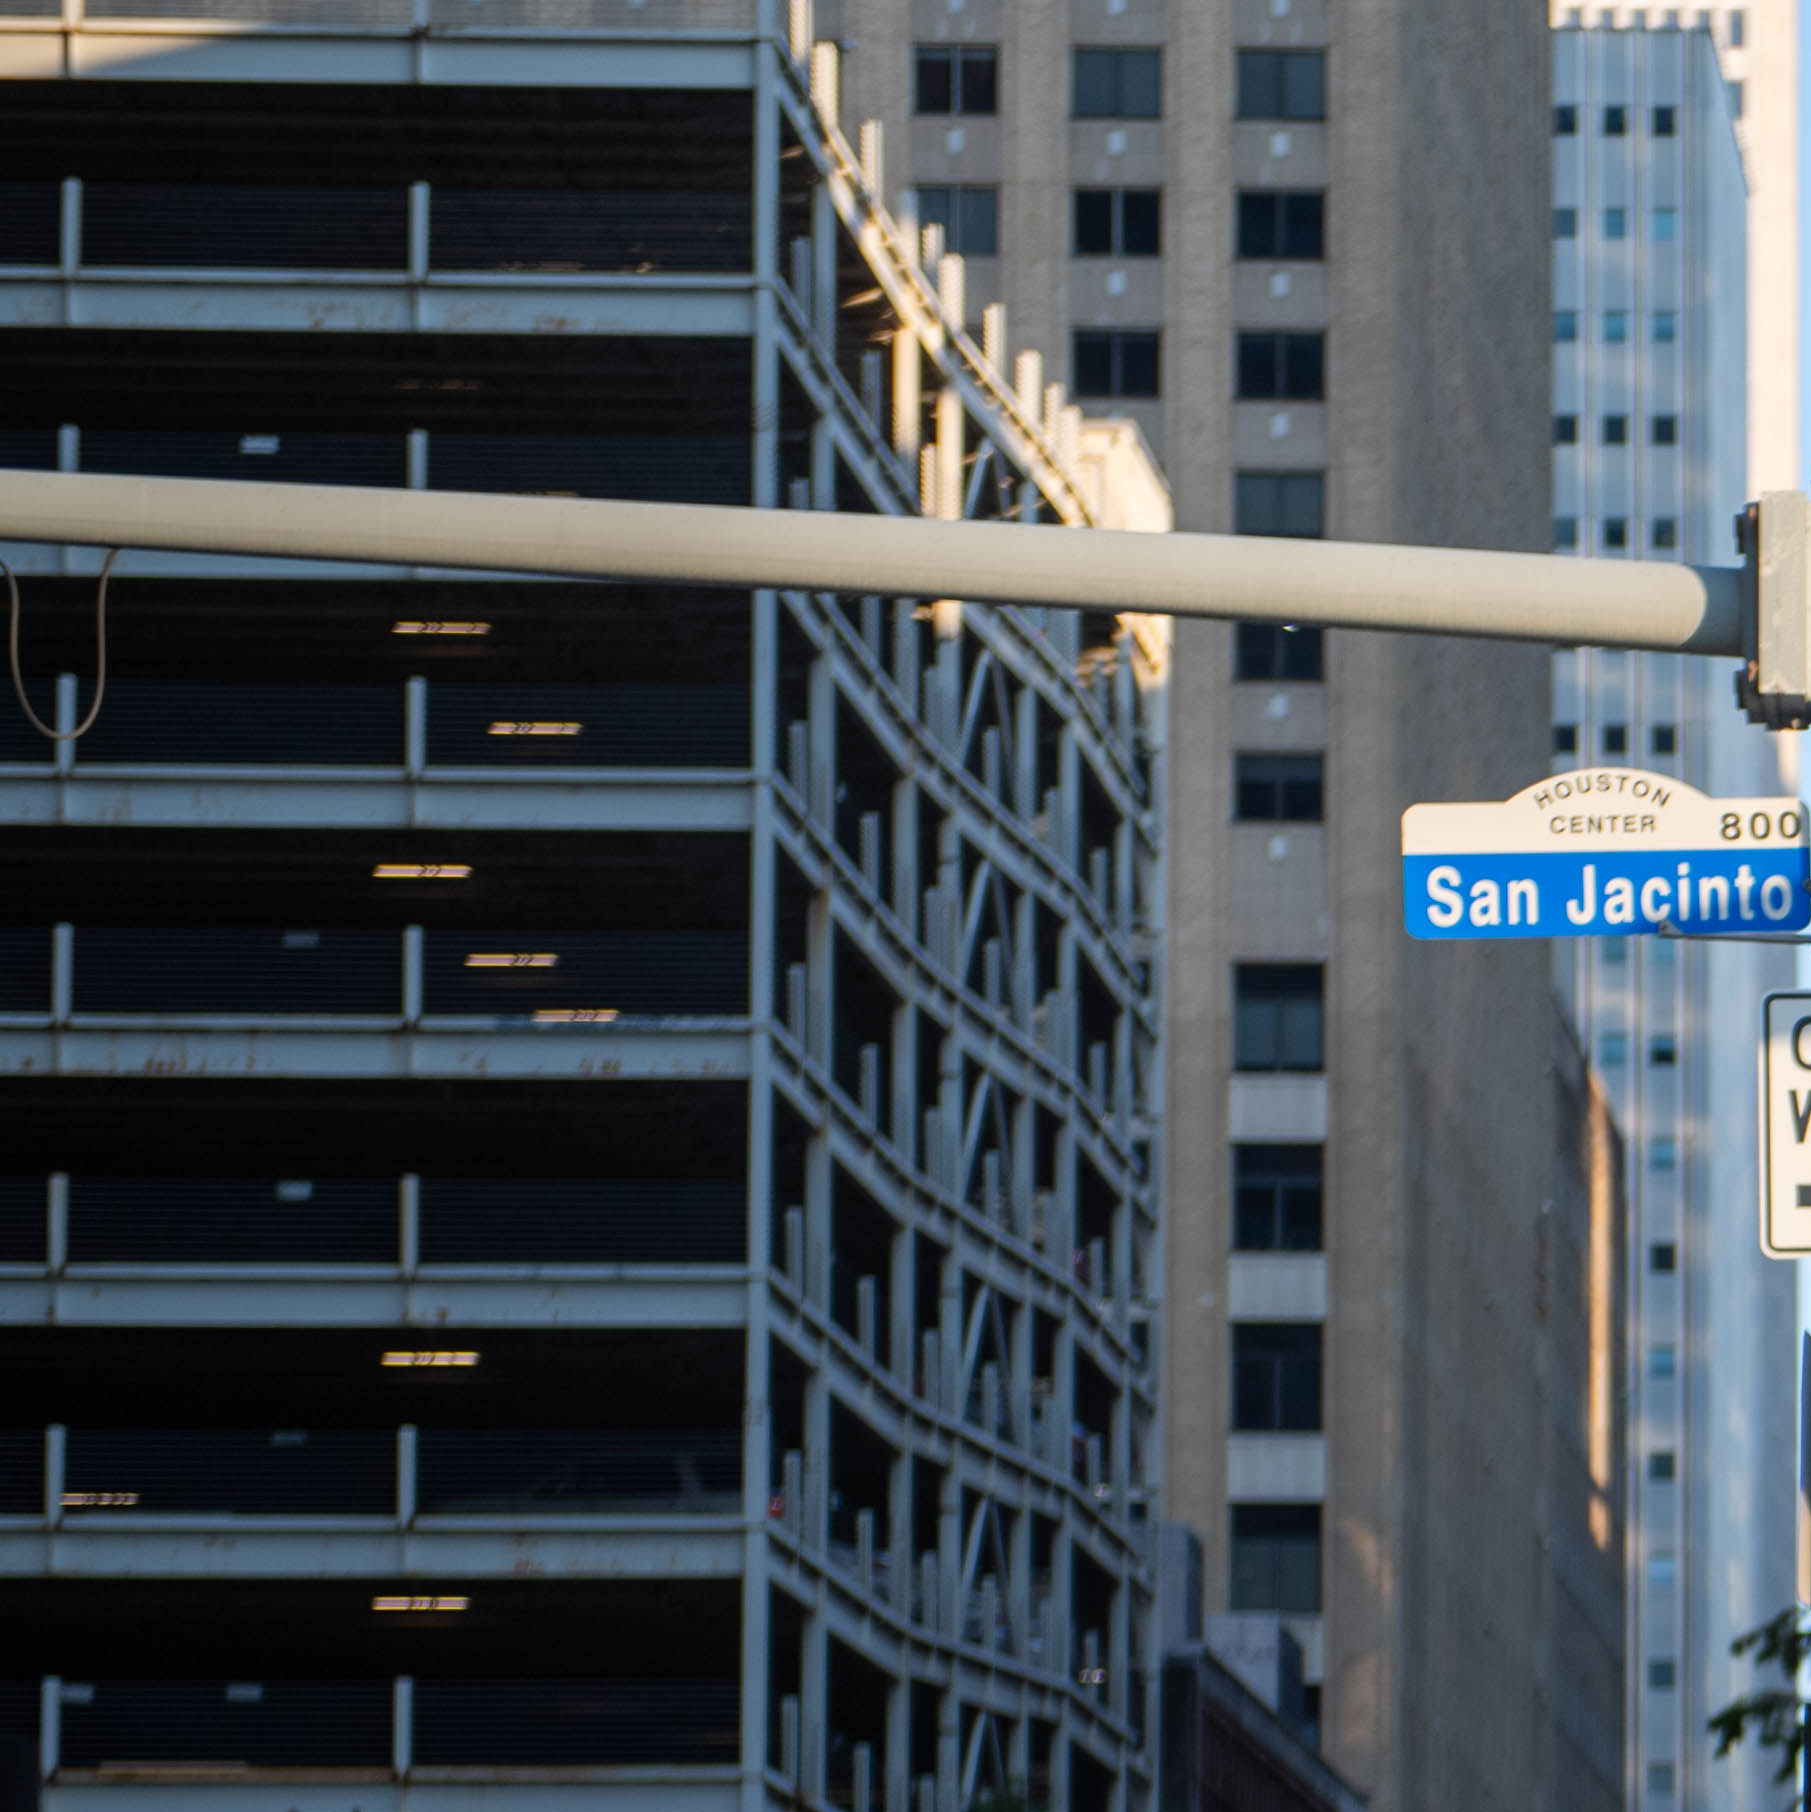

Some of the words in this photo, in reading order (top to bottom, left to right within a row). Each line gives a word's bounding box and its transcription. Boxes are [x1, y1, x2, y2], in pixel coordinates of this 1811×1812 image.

[1533, 774, 1671, 810] HOUSTON
[1549, 815, 1656, 835] CENTER
[1720, 811, 1803, 841] 800
[1425, 865, 1540, 928] San
[1566, 863, 1793, 924] Jacinto
